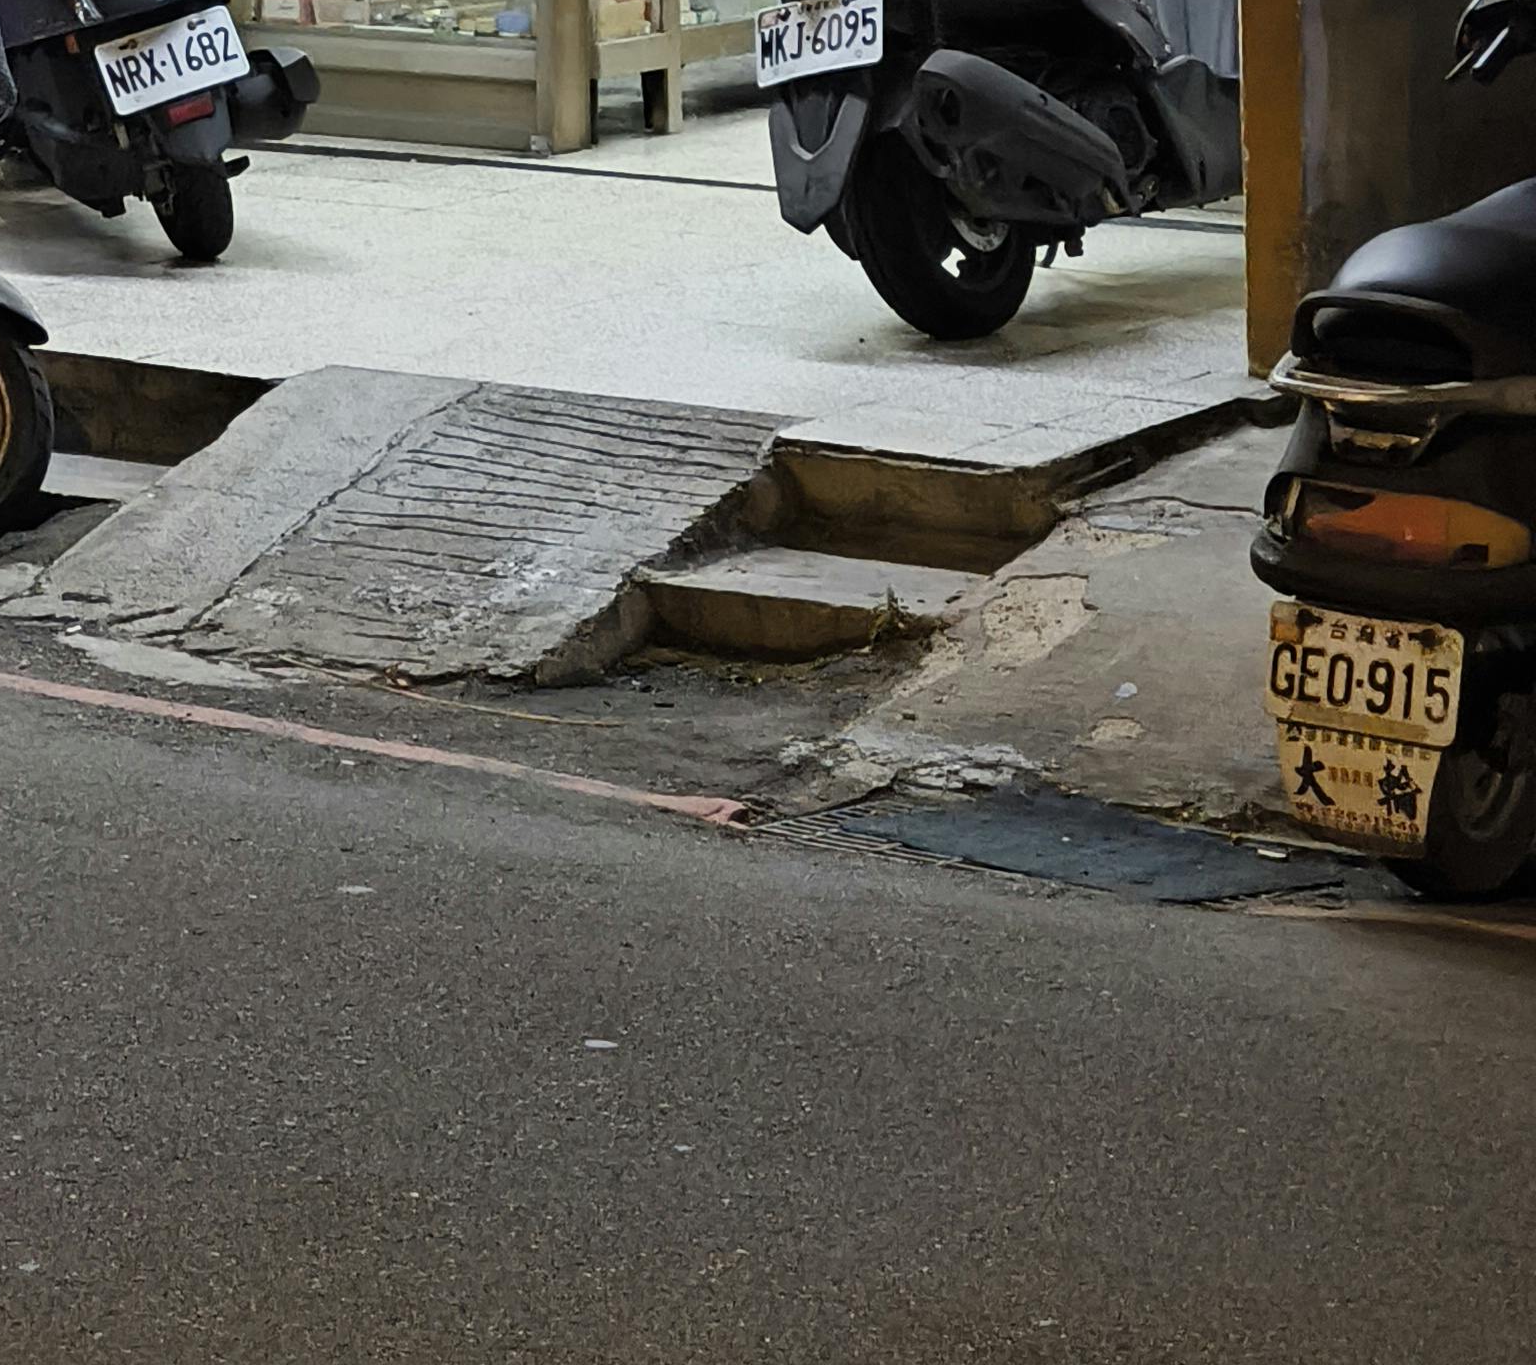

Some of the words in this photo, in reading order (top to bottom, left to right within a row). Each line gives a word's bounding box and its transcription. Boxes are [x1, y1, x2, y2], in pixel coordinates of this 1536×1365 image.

[105, 25, 239, 99] NRX-1682
[759, 6, 878, 71] MKJ-6095
[1269, 642, 1452, 725] GEO-915
